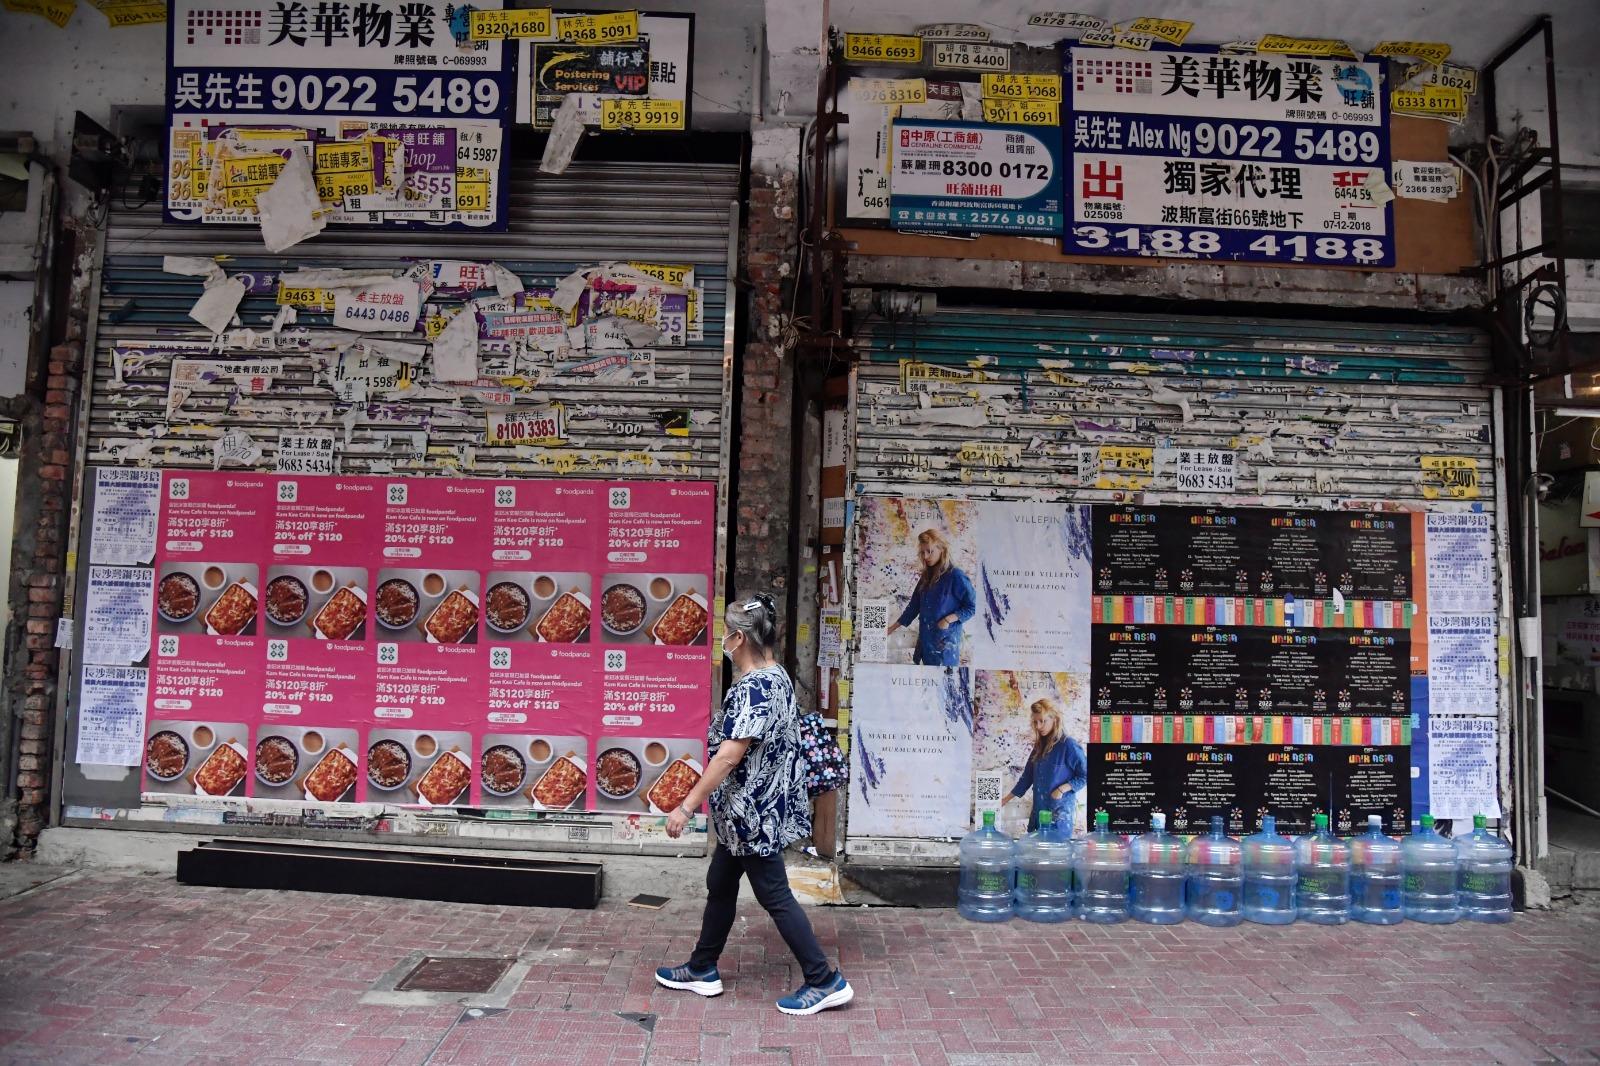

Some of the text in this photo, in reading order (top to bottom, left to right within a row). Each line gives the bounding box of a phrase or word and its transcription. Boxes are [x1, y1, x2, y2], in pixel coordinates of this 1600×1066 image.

[268, 2, 436, 48] 美華物業
[477, 22, 545, 35] 9320 1680
[1032, 17, 1100, 29] 9178 4400
[564, 25, 632, 41] 9368 5091
[1086, 32, 1116, 42] 6204
[1152, 24, 1183, 39] 5091
[851, 45, 916, 58] 9466 6693
[394, 54, 487, 65] 牌照號碼 C-069993
[938, 52, 1005, 66] 9178 4400
[555, 70, 610, 80] Postering
[1160, 56, 1323, 104] 美華物業
[555, 82, 600, 92] Services
[614, 74, 646, 91] VIP
[1442, 76, 1472, 90] 0624
[174, 72, 500, 115] 吳先生 9022 5489
[889, 89, 922, 100] 8316
[991, 84, 1057, 97] 9463 1068
[1397, 97, 1457, 108] 6333 8171
[608, 111, 679, 124] 9283 9919
[1023, 111, 1052, 122] 6691
[1286, 109, 1327, 120] 牌照號碼
[1074, 116, 1380, 163] 吳先生 Alex Ng 9022 5489
[473, 148, 498, 162] 5987
[943, 161, 993, 177] 8300
[1000, 163, 1049, 180] 0172
[1083, 161, 1124, 200] 出
[1163, 161, 1303, 200] 獨家代理
[339, 184, 368, 196] 3689
[946, 183, 1003, 197] 旺舖出租
[351, 199, 361, 209] 租
[971, 213, 1010, 224] 2576
[1016, 214, 1054, 226] 8081
[1083, 210, 1124, 221] 025098
[1161, 205, 1304, 230] 波斯富街66號地下
[1323, 221, 1371, 231] 07-12-2018
[1075, 226, 1385, 261] 3188 4188
[285, 290, 316, 302] 9463
[346, 307, 410, 322] 6443 0486
[251, 377, 265, 392] 售
[373, 375, 398, 388] 5987
[496, 419, 556, 440] 8100 3383
[281, 437, 332, 450] 業主放盤
[1179, 451, 1234, 465] 業主放盤
[278, 458, 331, 473] 9683 5434
[1178, 474, 1234, 489] 9683 5434
[1015, 515, 1061, 524] VILLEPIN
[275, 532, 295, 540] 20%
[318, 533, 342, 541] $120
[429, 536, 453, 544] $120
[654, 540, 679, 548] $120
[993, 569, 1080, 578] MARIE DE VILLEPIN
[891, 677, 939, 687] VILLEPIN
[869, 733, 896, 741] MARIE
[917, 734, 958, 742] VILLEPIN
